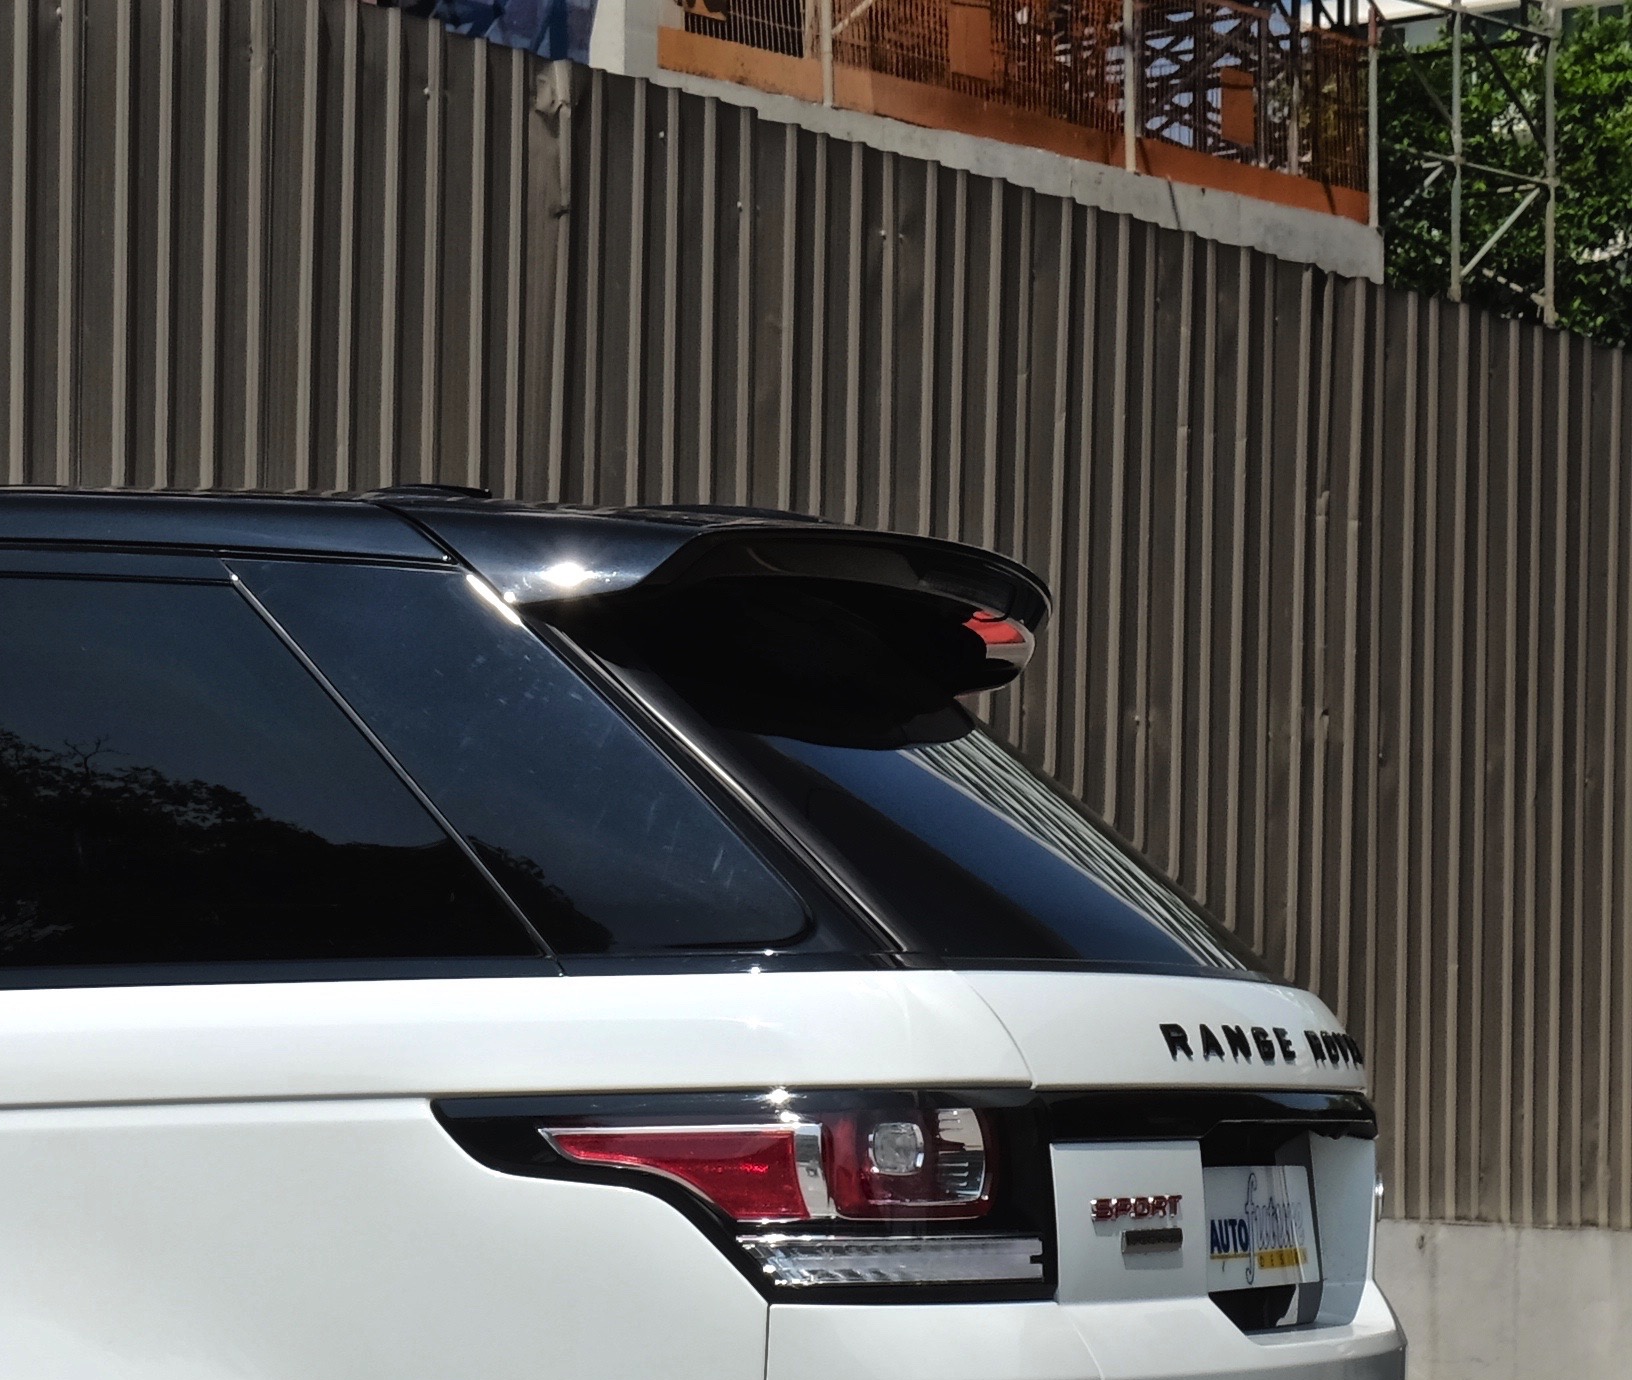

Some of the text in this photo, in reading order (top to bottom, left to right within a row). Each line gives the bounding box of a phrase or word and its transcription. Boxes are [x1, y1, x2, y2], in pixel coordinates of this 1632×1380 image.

[1159, 1023, 1296, 1062] RANGE
[1090, 1194, 1183, 1221] SPORT
[1210, 1218, 1250, 1255] AUTO
